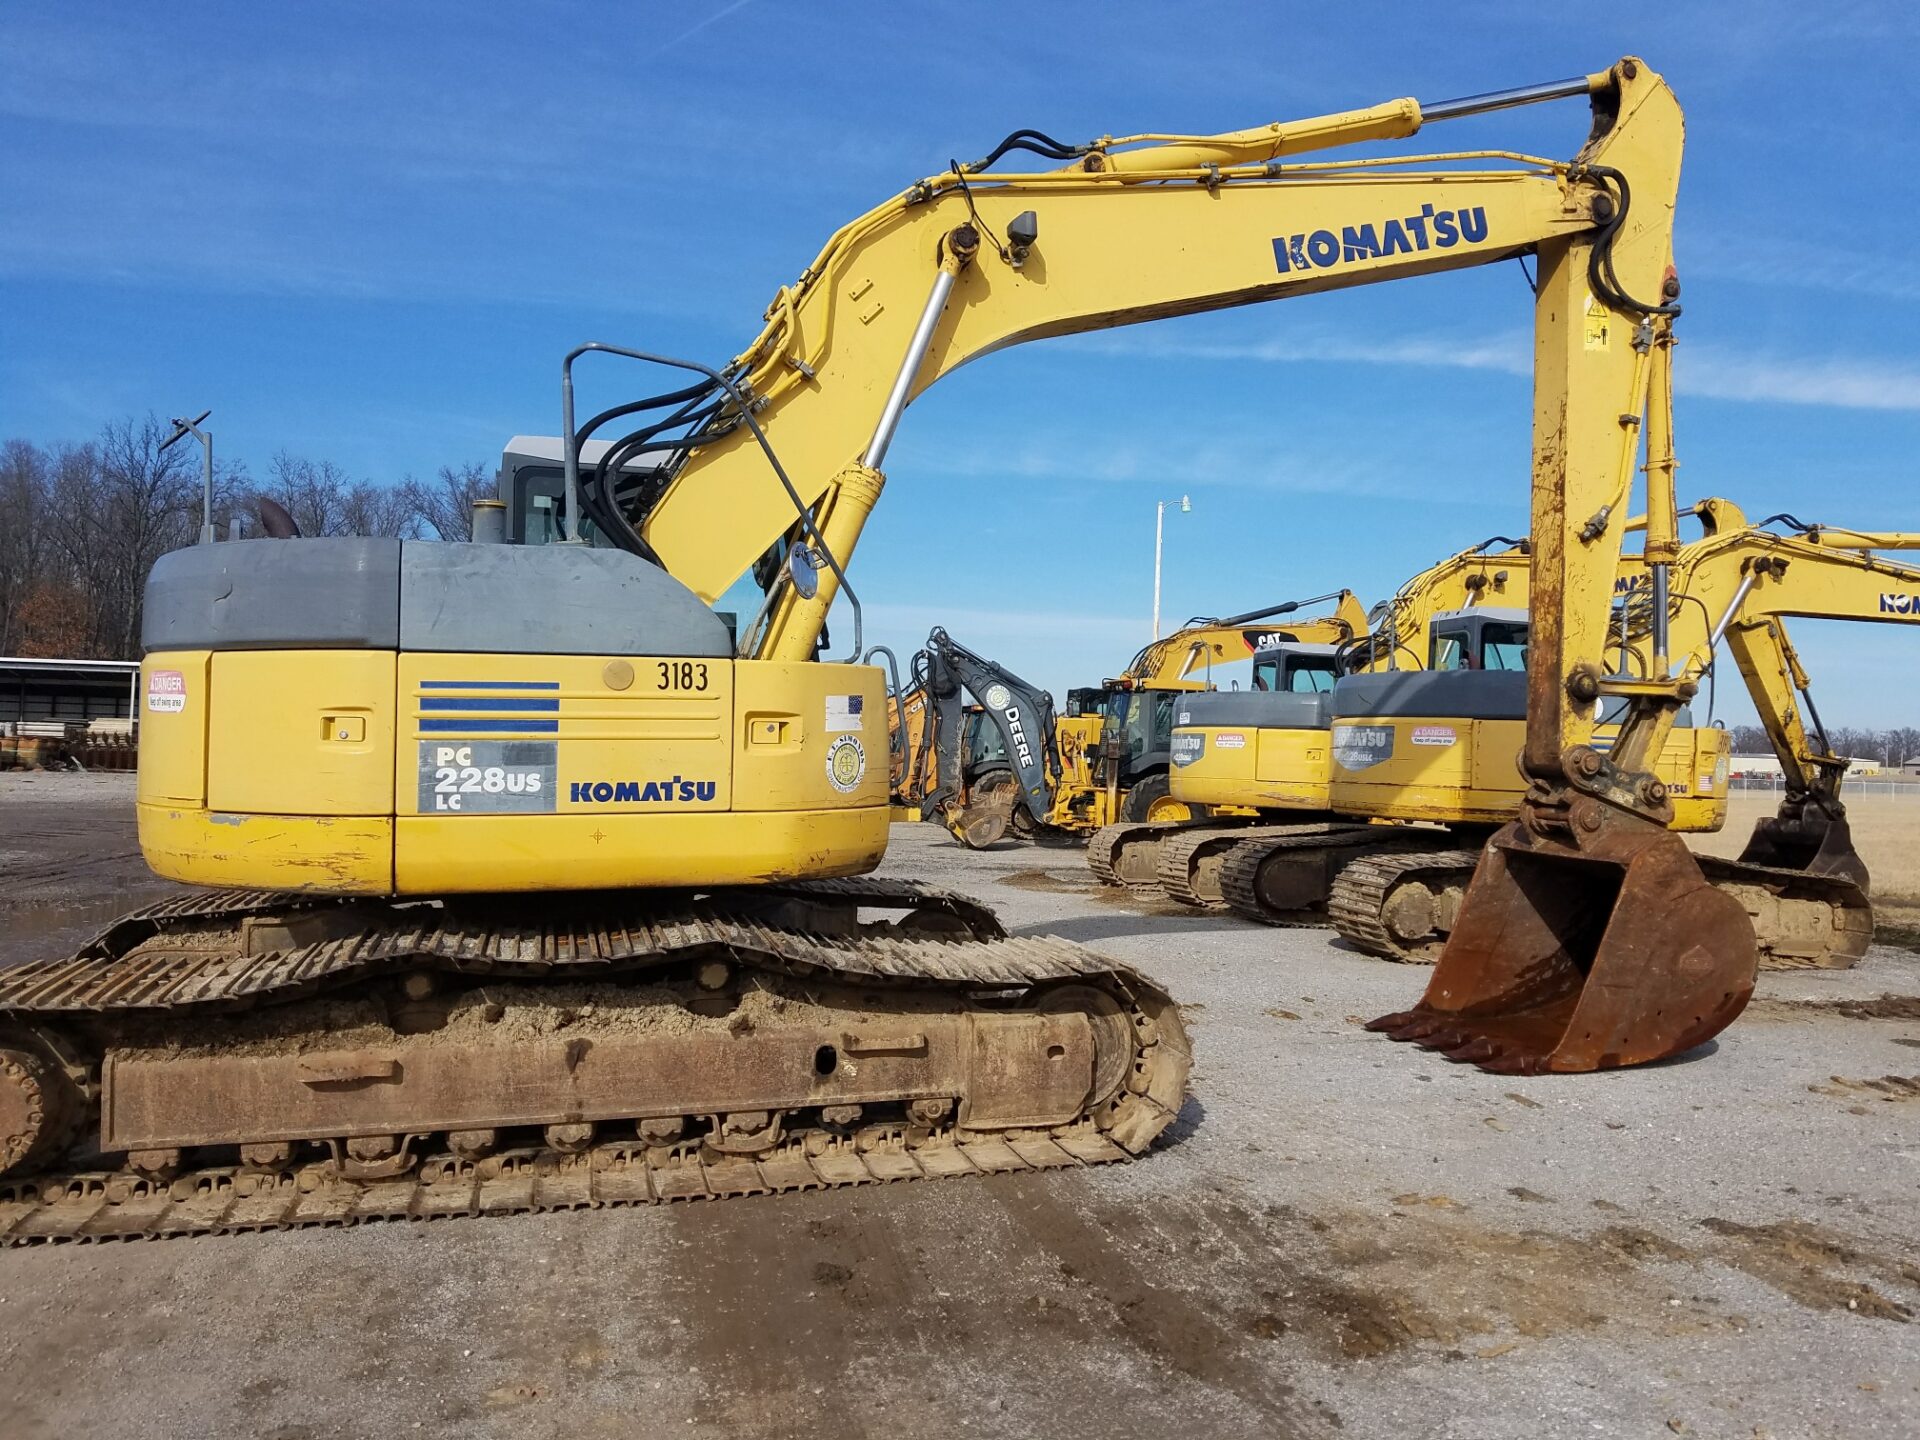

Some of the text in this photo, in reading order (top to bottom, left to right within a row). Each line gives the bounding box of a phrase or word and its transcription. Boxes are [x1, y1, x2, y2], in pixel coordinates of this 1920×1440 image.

[1272, 203, 1488, 273] KOMATSU
[1258, 632, 1280, 646] CAT
[154, 677, 182, 691] DANGER
[657, 662, 708, 691] 3183
[1005, 706, 1034, 769] DEERE
[1422, 729, 1453, 737] DANGER
[437, 747, 471, 766] PC
[570, 776, 716, 802] KOMATSU
[436, 794, 461, 810] LC
